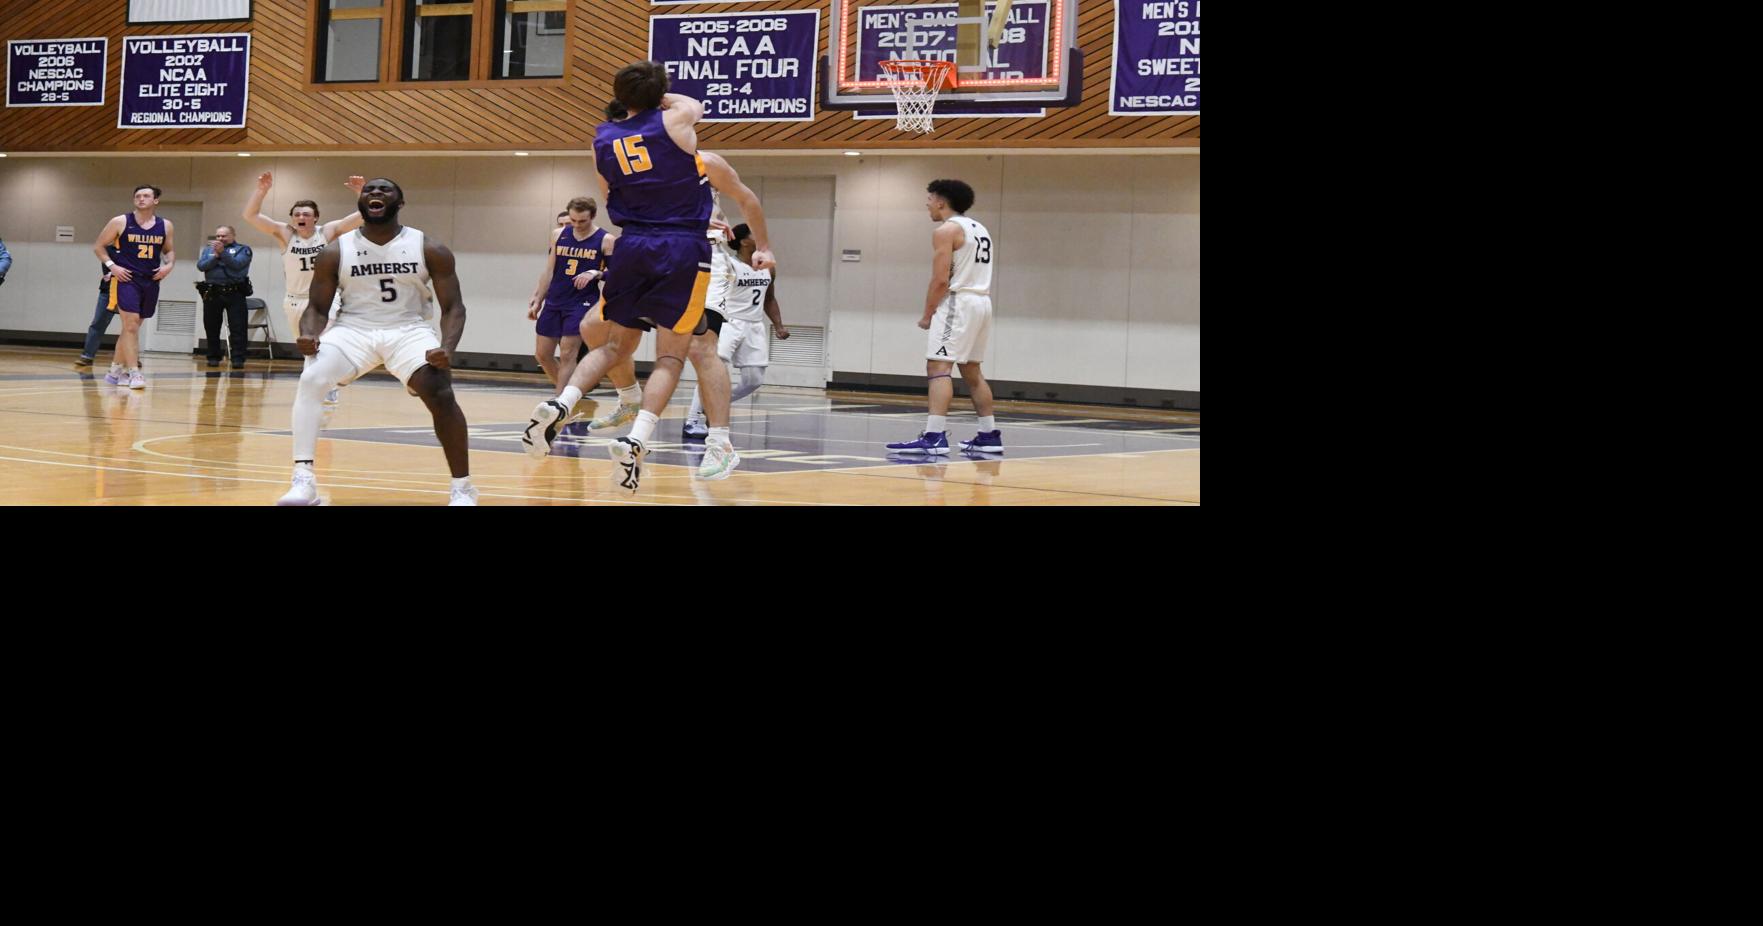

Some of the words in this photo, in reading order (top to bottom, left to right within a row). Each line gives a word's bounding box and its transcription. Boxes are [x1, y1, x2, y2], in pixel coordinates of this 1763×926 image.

[1142, 0, 1189, 19] MEN'S
[922, 8, 1040, 27] BASALL
[679, 18, 788, 34] 2005-2006
[14, 42, 101, 56] VOLLEYBALL
[129, 38, 244, 54] VOLLEYBALL
[687, 35, 776, 57] NCAA
[38, 55, 75, 67] 2006
[164, 54, 205, 67] 2007
[28, 68, 84, 80] NESCAC
[159, 67, 207, 82] NCAA
[664, 59, 729, 80] FINAL
[735, 57, 799, 79] FOUR
[17, 80, 95, 92] CHAMPIONS
[138, 83, 181, 97] ELITE
[184, 82, 228, 96] EIGHT
[706, 82, 753, 96] 28-4
[40, 92, 70, 101] 28-5
[162, 98, 202, 110] 30-5
[1120, 94, 1197, 108] NESCAC
[718, 98, 807, 114] CHAMPIONS
[130, 112, 176, 124] REGIONAL
[179, 111, 232, 123] CHAMPIONS
[613, 134, 653, 175] 15
[137, 244, 154, 259] 21
[556, 245, 598, 260] WILLIAMS
[350, 262, 419, 277] AMHERST
[565, 259, 579, 276] 3
[379, 278, 397, 303] 5
[752, 288, 761, 306] 2
[935, 345, 948, 356] A
